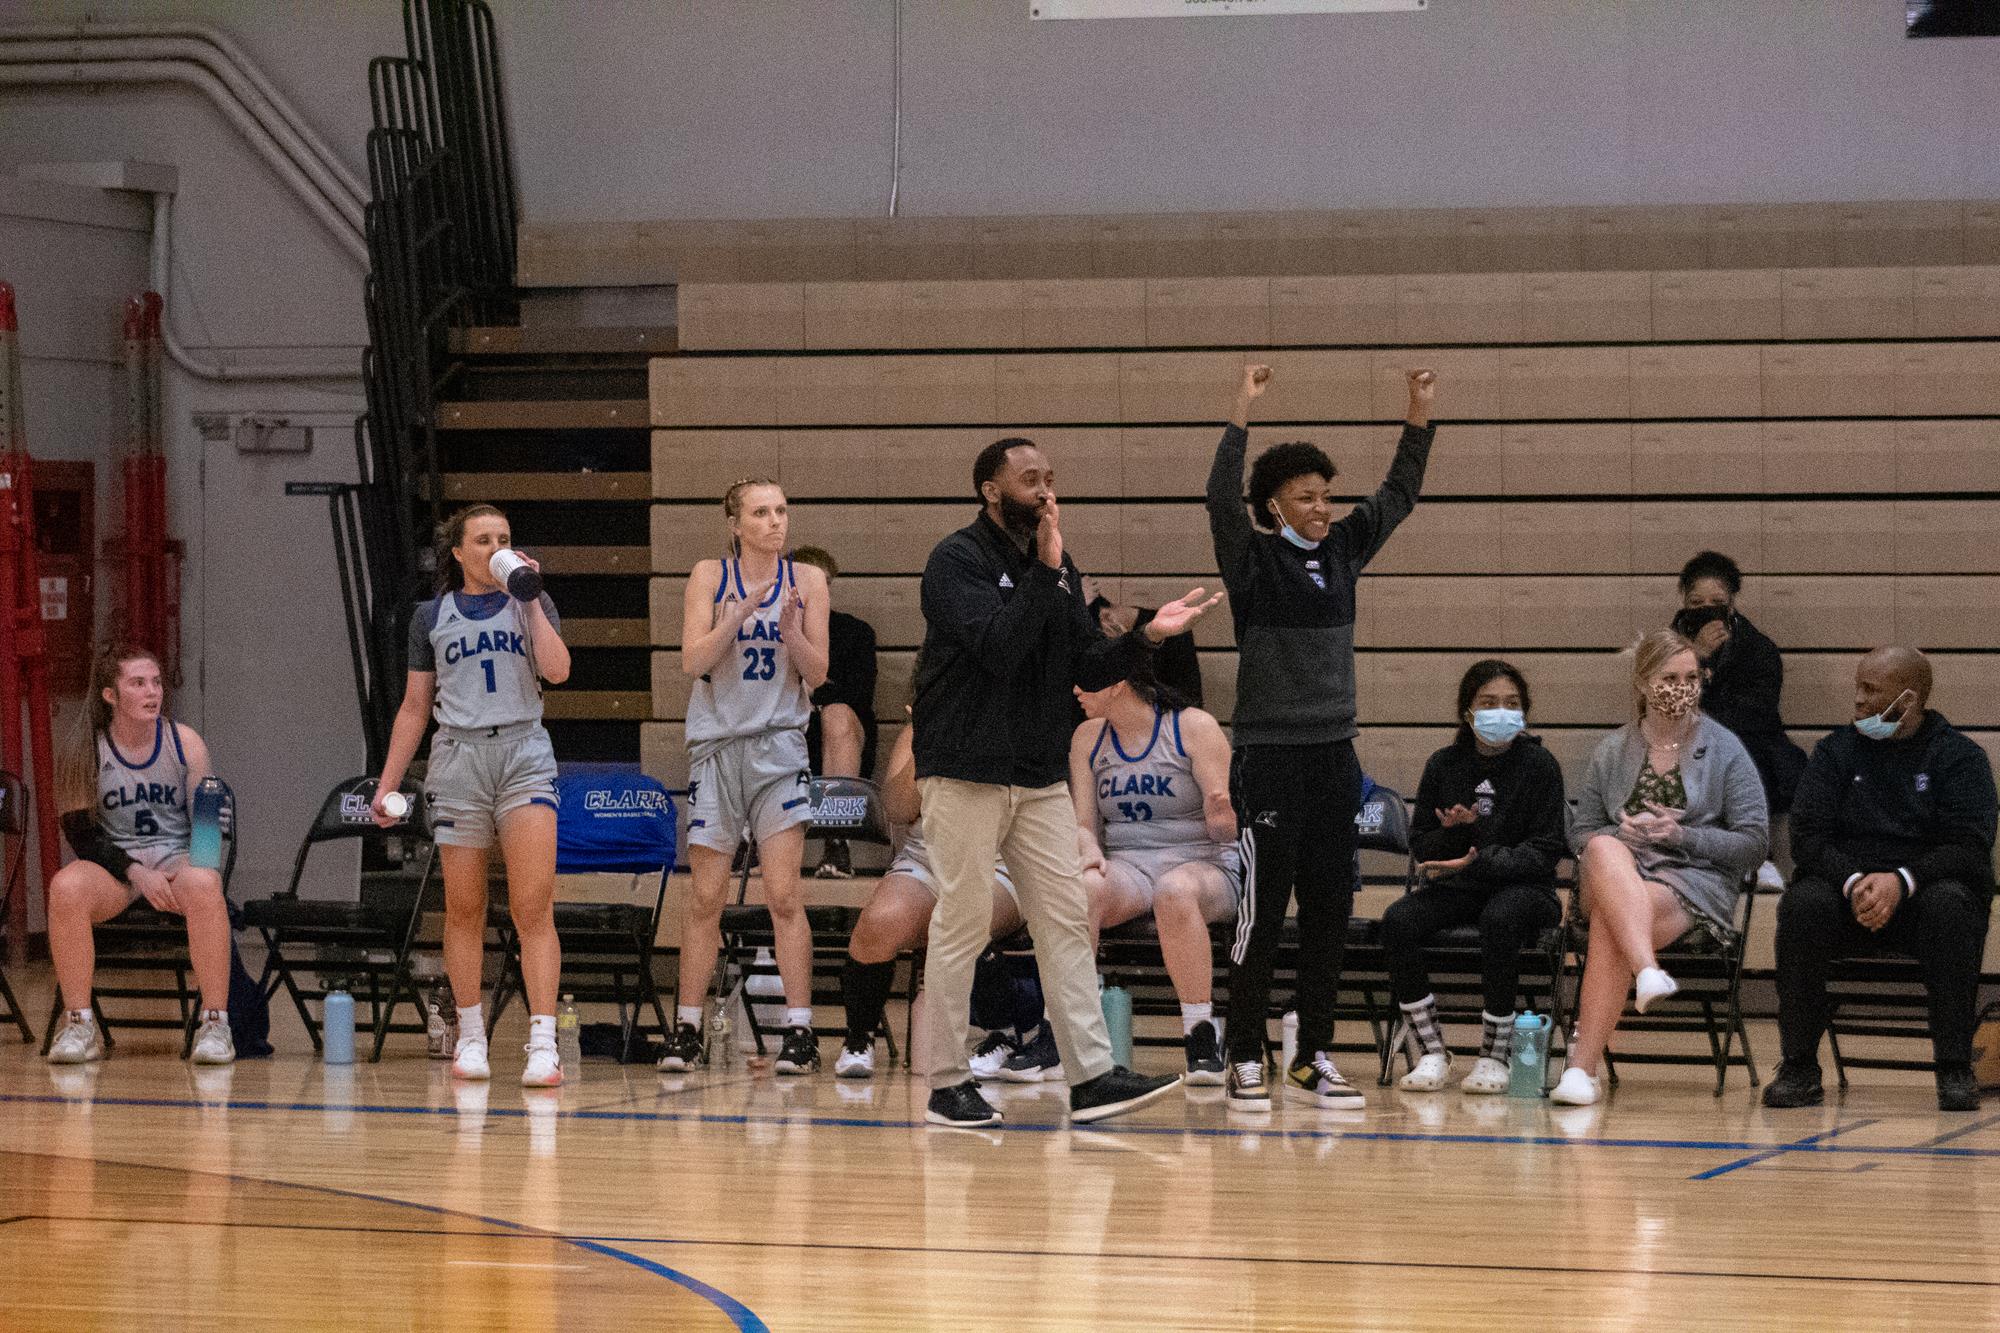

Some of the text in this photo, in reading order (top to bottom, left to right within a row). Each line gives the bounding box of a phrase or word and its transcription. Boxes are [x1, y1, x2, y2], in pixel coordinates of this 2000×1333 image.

[737, 619, 785, 643] LAR
[445, 630, 526, 665] CLARK
[480, 659, 497, 693] 1
[743, 647, 776, 681] 23
[103, 782, 177, 810] CLARK
[1099, 774, 1176, 799] CLARK
[341, 793, 417, 817] CLK
[584, 790, 669, 814] CLARK
[810, 797, 866, 816] ARK
[135, 808, 159, 836] 5
